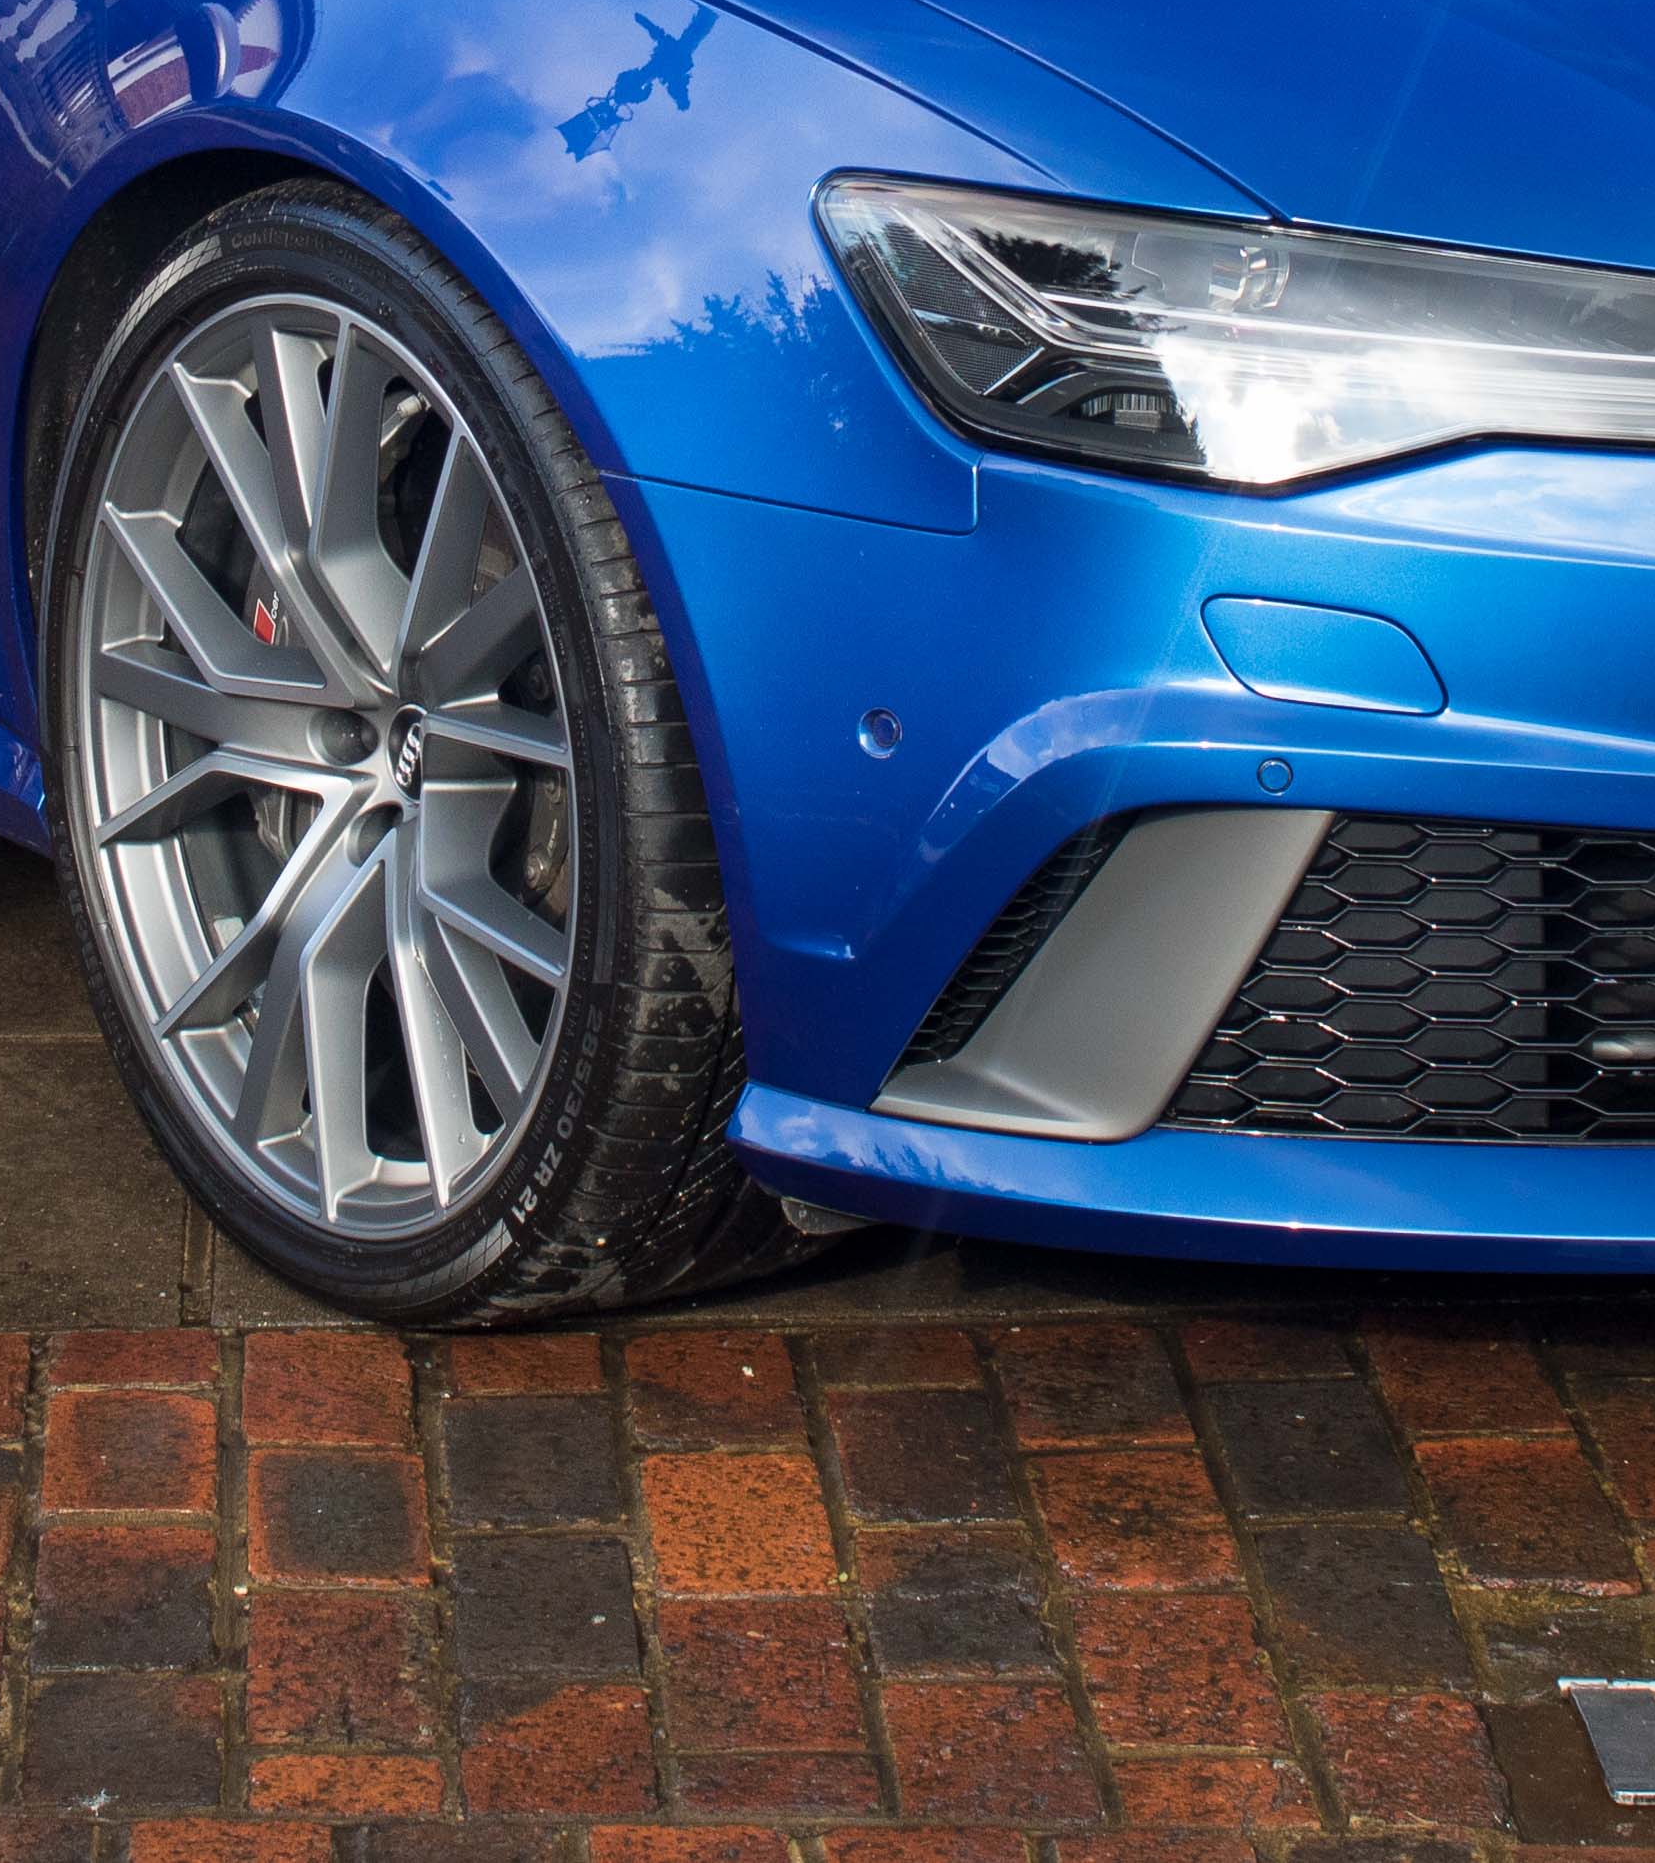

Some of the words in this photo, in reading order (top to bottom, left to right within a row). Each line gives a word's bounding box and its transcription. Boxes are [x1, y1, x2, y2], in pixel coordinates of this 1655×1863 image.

[556, 1002, 604, 1140] 285/30
[533, 1141, 564, 1188] ZR
[510, 1184, 539, 1225] 21
